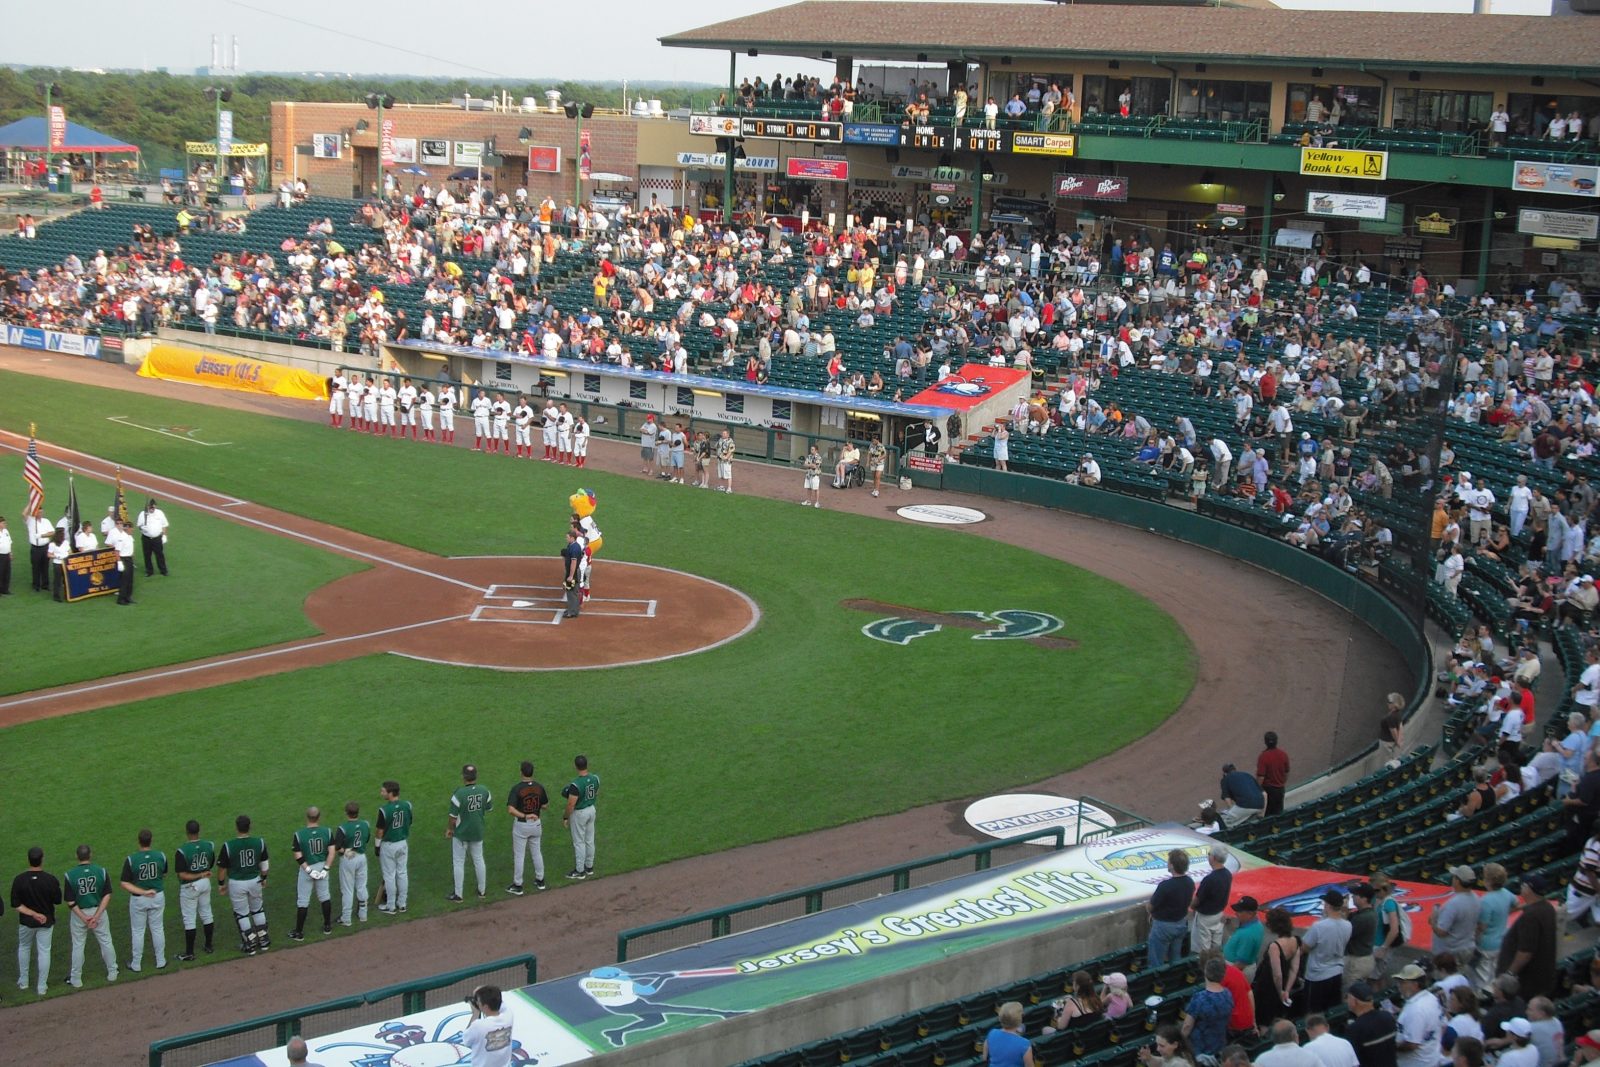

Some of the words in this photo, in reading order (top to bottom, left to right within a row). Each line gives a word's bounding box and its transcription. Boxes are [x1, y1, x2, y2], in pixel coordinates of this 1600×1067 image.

[743, 123, 756, 132] BALL
[766, 124, 786, 134] STRIKE
[796, 126, 808, 135] OUT
[820, 127, 830, 136] INN
[915, 126, 935, 135] HOME
[970, 129, 1001, 139] VISITORS
[901, 134, 907, 145] R
[922, 135, 928, 146] H
[939, 136, 945, 147] E
[956, 137, 962, 148] R
[978, 139, 984, 149] H
[996, 140, 1002, 150] E
[1015, 136, 1044, 146] SMART
[1045, 138, 1072, 149] Carpet
[745, 157, 775, 169] COURT
[1307, 151, 1345, 162] Yellow
[933, 169, 960, 180] FOOD
[1303, 162, 1332, 173] Book
[1335, 164, 1358, 175] USA
[1060, 180, 1084, 192] Pepper
[1067, 176, 1076, 184] Dr
[1096, 182, 1121, 194] Pepper
[194, 356, 232, 377] JERSEY
[717, 412, 752, 424] WACHOVIA
[467, 794, 483, 812] 25
[392, 810, 404, 829] 21
[353, 831, 362, 848] 2
[308, 837, 324, 856] 10
[190, 851, 208, 872] 34
[239, 848, 256, 868] 18
[138, 861, 158, 881] 20
[77, 875, 97, 896] 32
[739, 929, 890, 973] Jersey's
[881, 885, 1047, 936] Greatest
[1013, 871, 1118, 904] Hits
